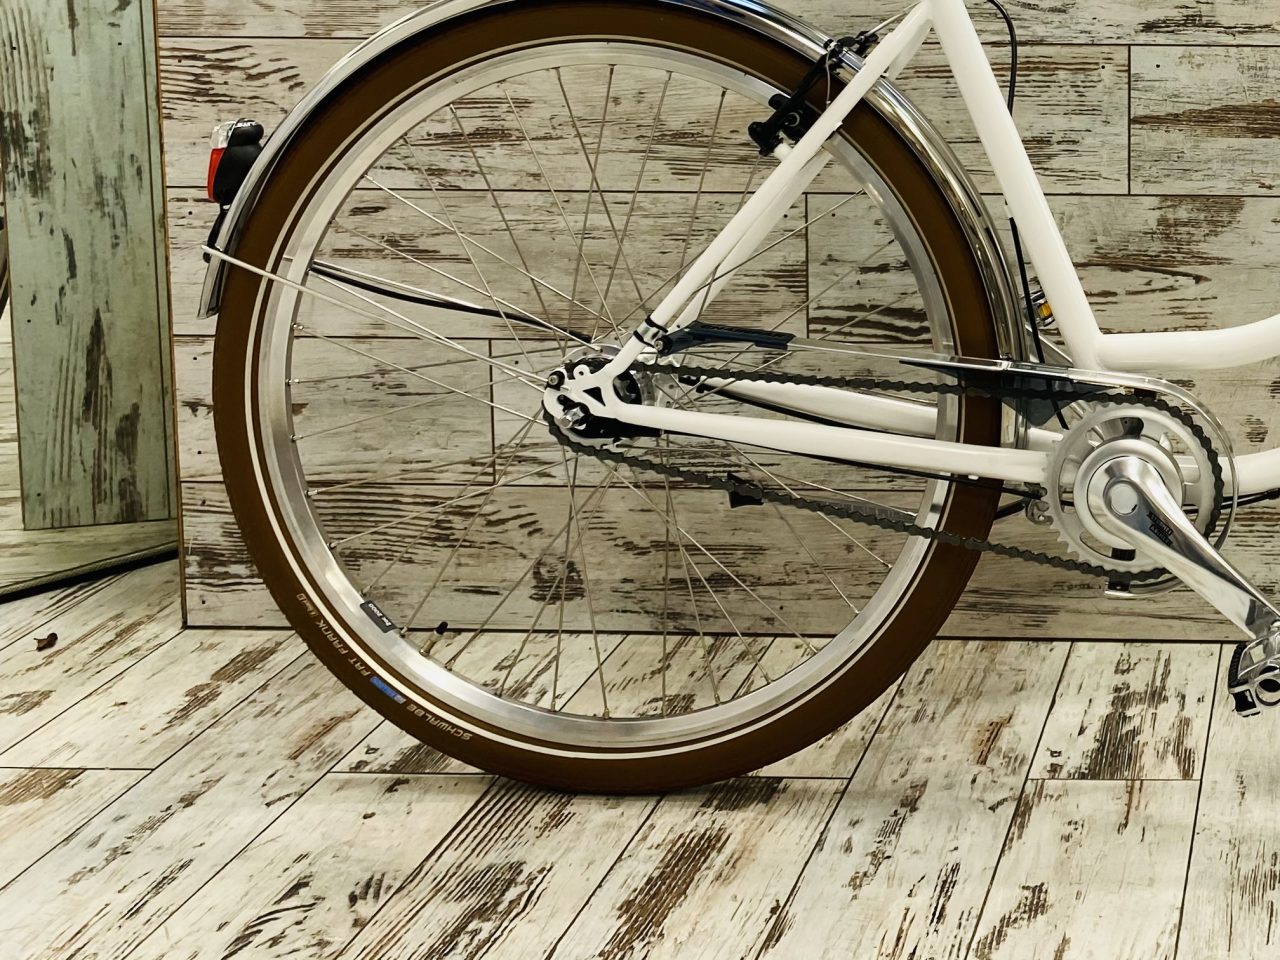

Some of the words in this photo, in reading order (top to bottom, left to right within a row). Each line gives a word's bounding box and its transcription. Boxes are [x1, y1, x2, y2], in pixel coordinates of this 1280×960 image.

[316, 619, 349, 655] FRANK
[348, 657, 372, 677] FAT
[406, 703, 473, 741] SCHWALBE
